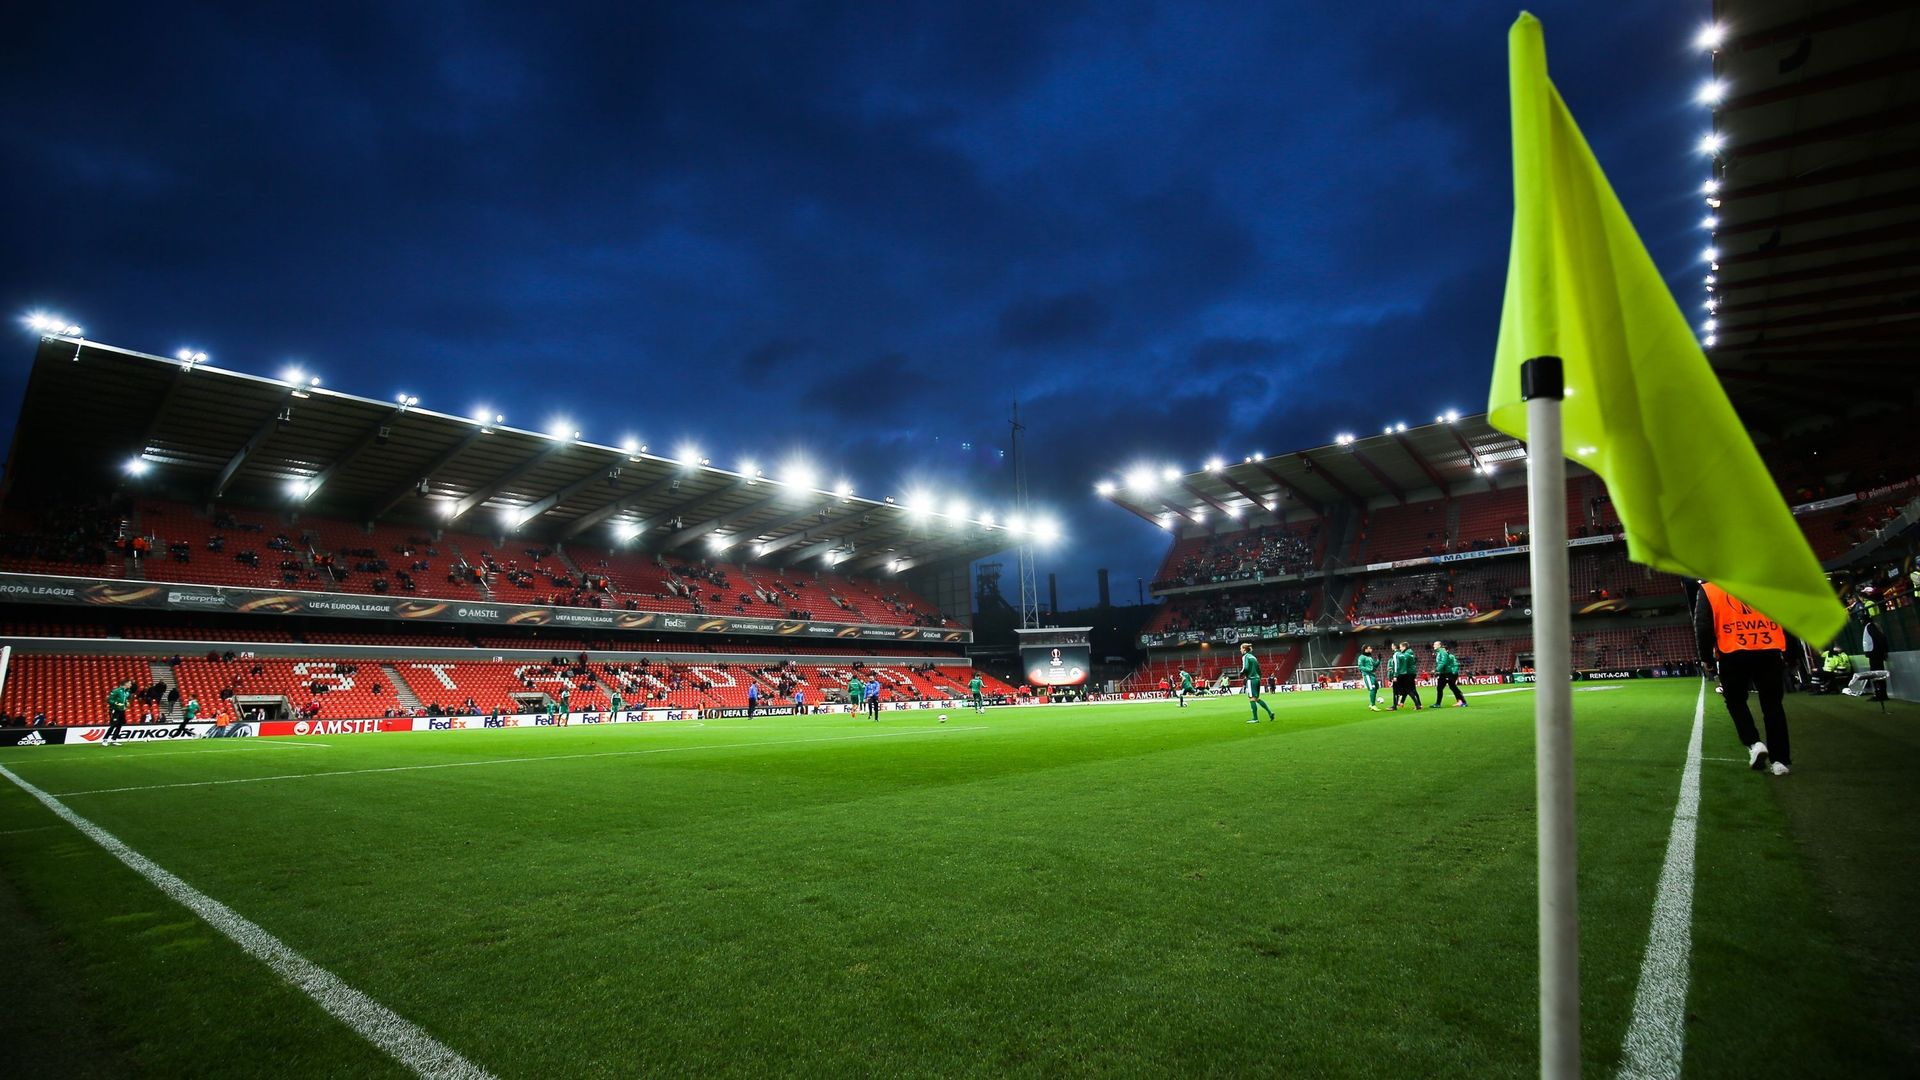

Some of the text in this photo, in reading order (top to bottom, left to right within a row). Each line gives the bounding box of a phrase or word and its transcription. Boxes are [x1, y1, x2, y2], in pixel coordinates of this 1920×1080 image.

[1443, 551, 1486, 561] MAFER
[32, 587, 75, 596] LEAGUE
[331, 603, 360, 611] EUROPA
[468, 609, 499, 618] AMSTEL
[1722, 620, 1778, 634] SEWAD
[1736, 632, 1772, 646] 373
[1136, 691, 1165, 700] AMSTEL
[895, 703, 912, 711] FedEx
[919, 702, 935, 710] FedEx
[941, 701, 956, 709] FedEx
[723, 707, 792, 717] UEFA EUOPA LEAGUE
[429, 717, 467, 730] FedEx
[582, 713, 611, 724] FedEx
[626, 712, 654, 722] FedEx
[667, 711, 693, 720] FedEx
[312, 719, 382, 735] AMSTEL
[103, 726, 196, 740] Hankook
